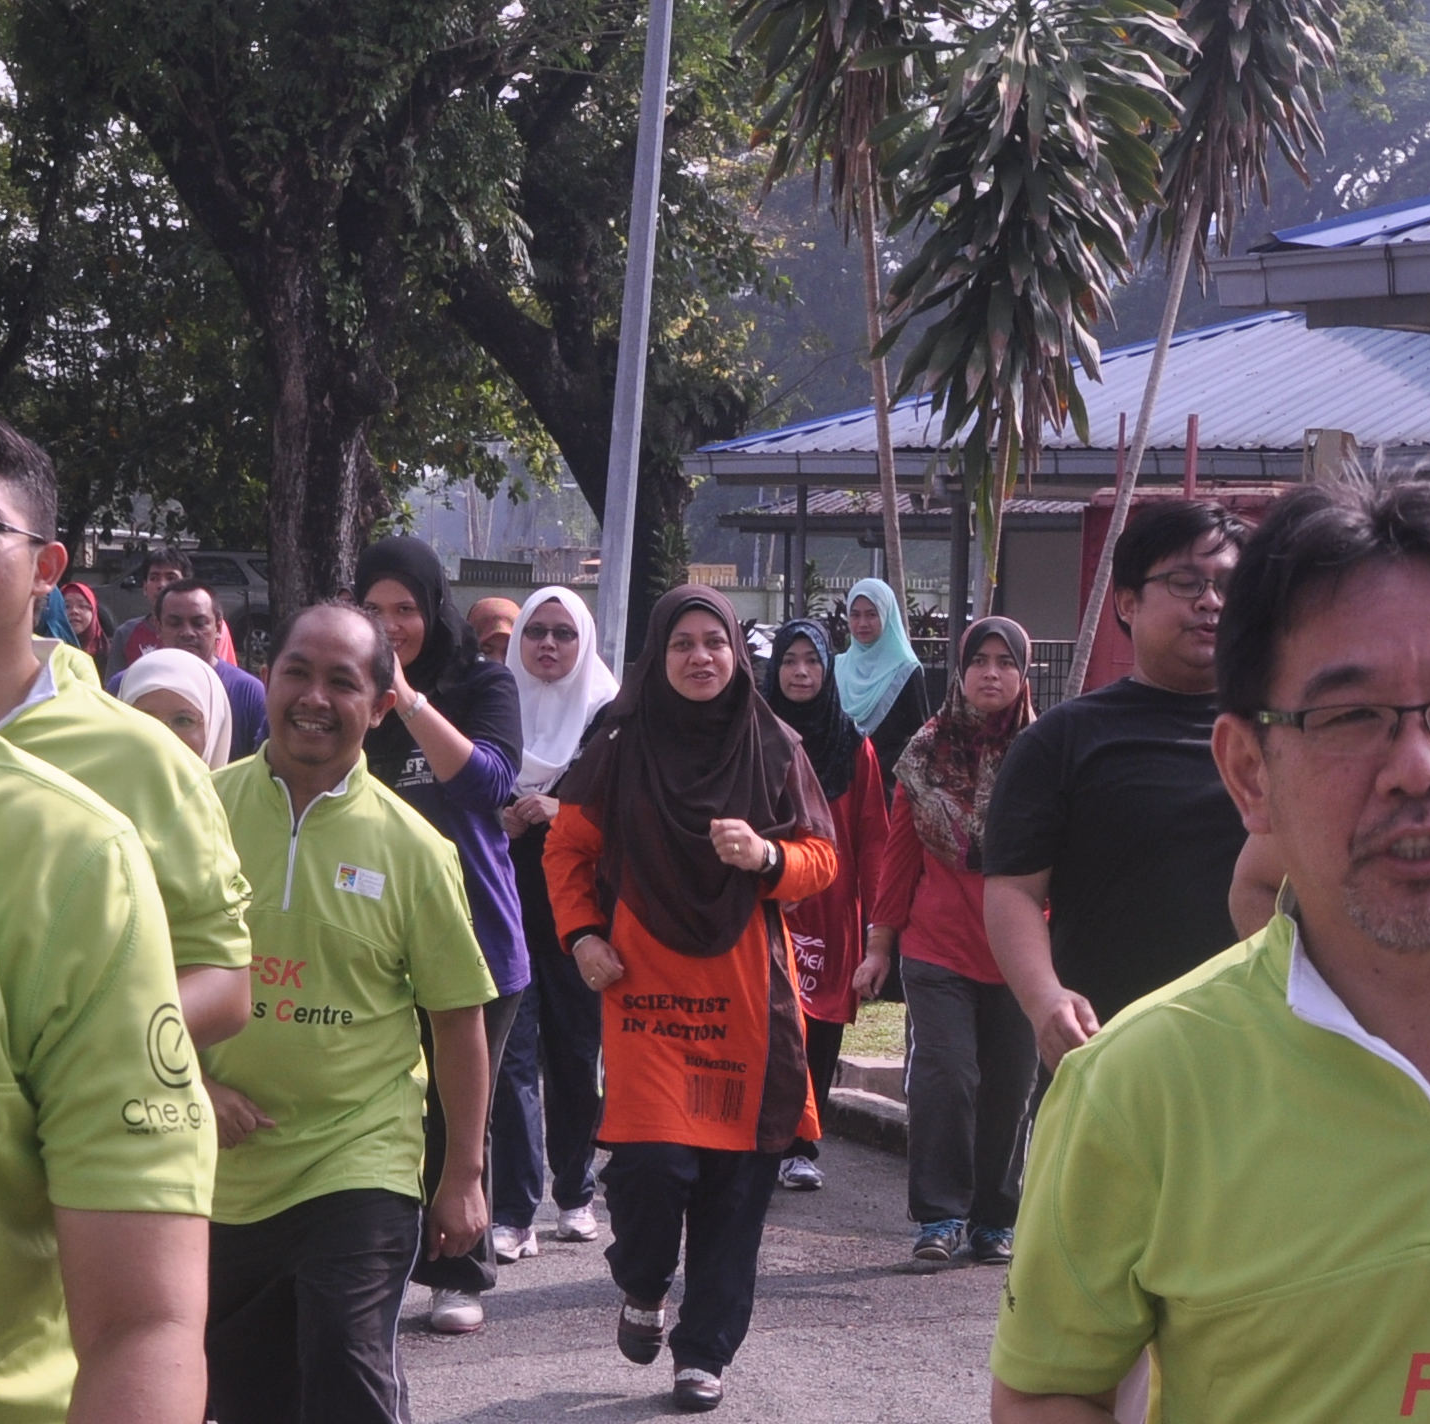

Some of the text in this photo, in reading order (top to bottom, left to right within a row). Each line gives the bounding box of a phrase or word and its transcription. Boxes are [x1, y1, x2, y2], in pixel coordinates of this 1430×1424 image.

[275, 999, 353, 1025] Centre
[622, 994, 730, 1013] SCIENTIST
[622, 1018, 728, 1041] IN ACTION
